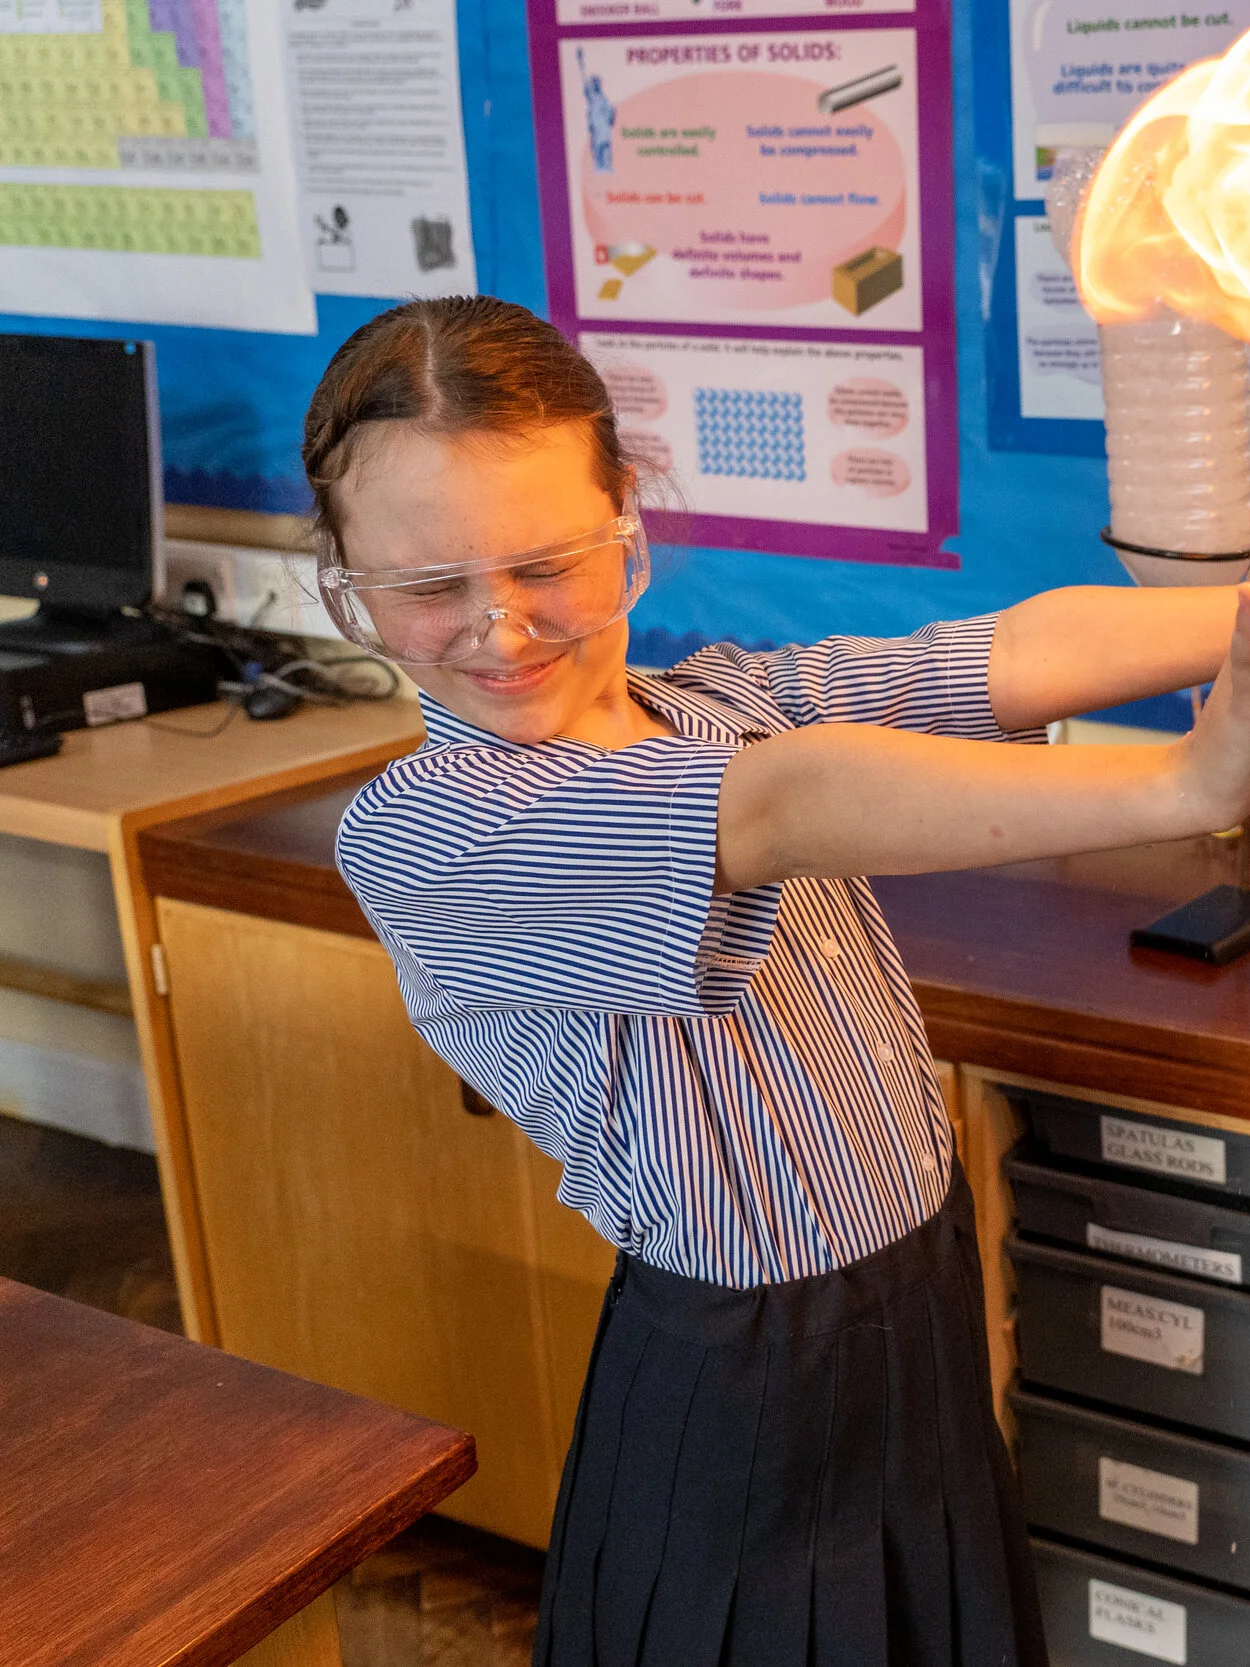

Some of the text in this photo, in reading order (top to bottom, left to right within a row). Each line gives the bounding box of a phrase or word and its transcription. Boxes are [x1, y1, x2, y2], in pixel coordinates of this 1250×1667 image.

[1066, 17, 1121, 36] Liquids
[1125, 15, 1176, 31] cannot
[1180, 12, 1199, 27] be
[627, 42, 841, 65] PROPERTIES OF SOLIDS:
[1060, 62, 1114, 80] Liquids
[1118, 63, 1142, 75] are
[1052, 79, 1113, 95] difficult
[1116, 79, 1134, 94] to
[1105, 1123, 1196, 1153] SPATULAS
[1106, 1142, 1214, 1177] GLASS RODS
